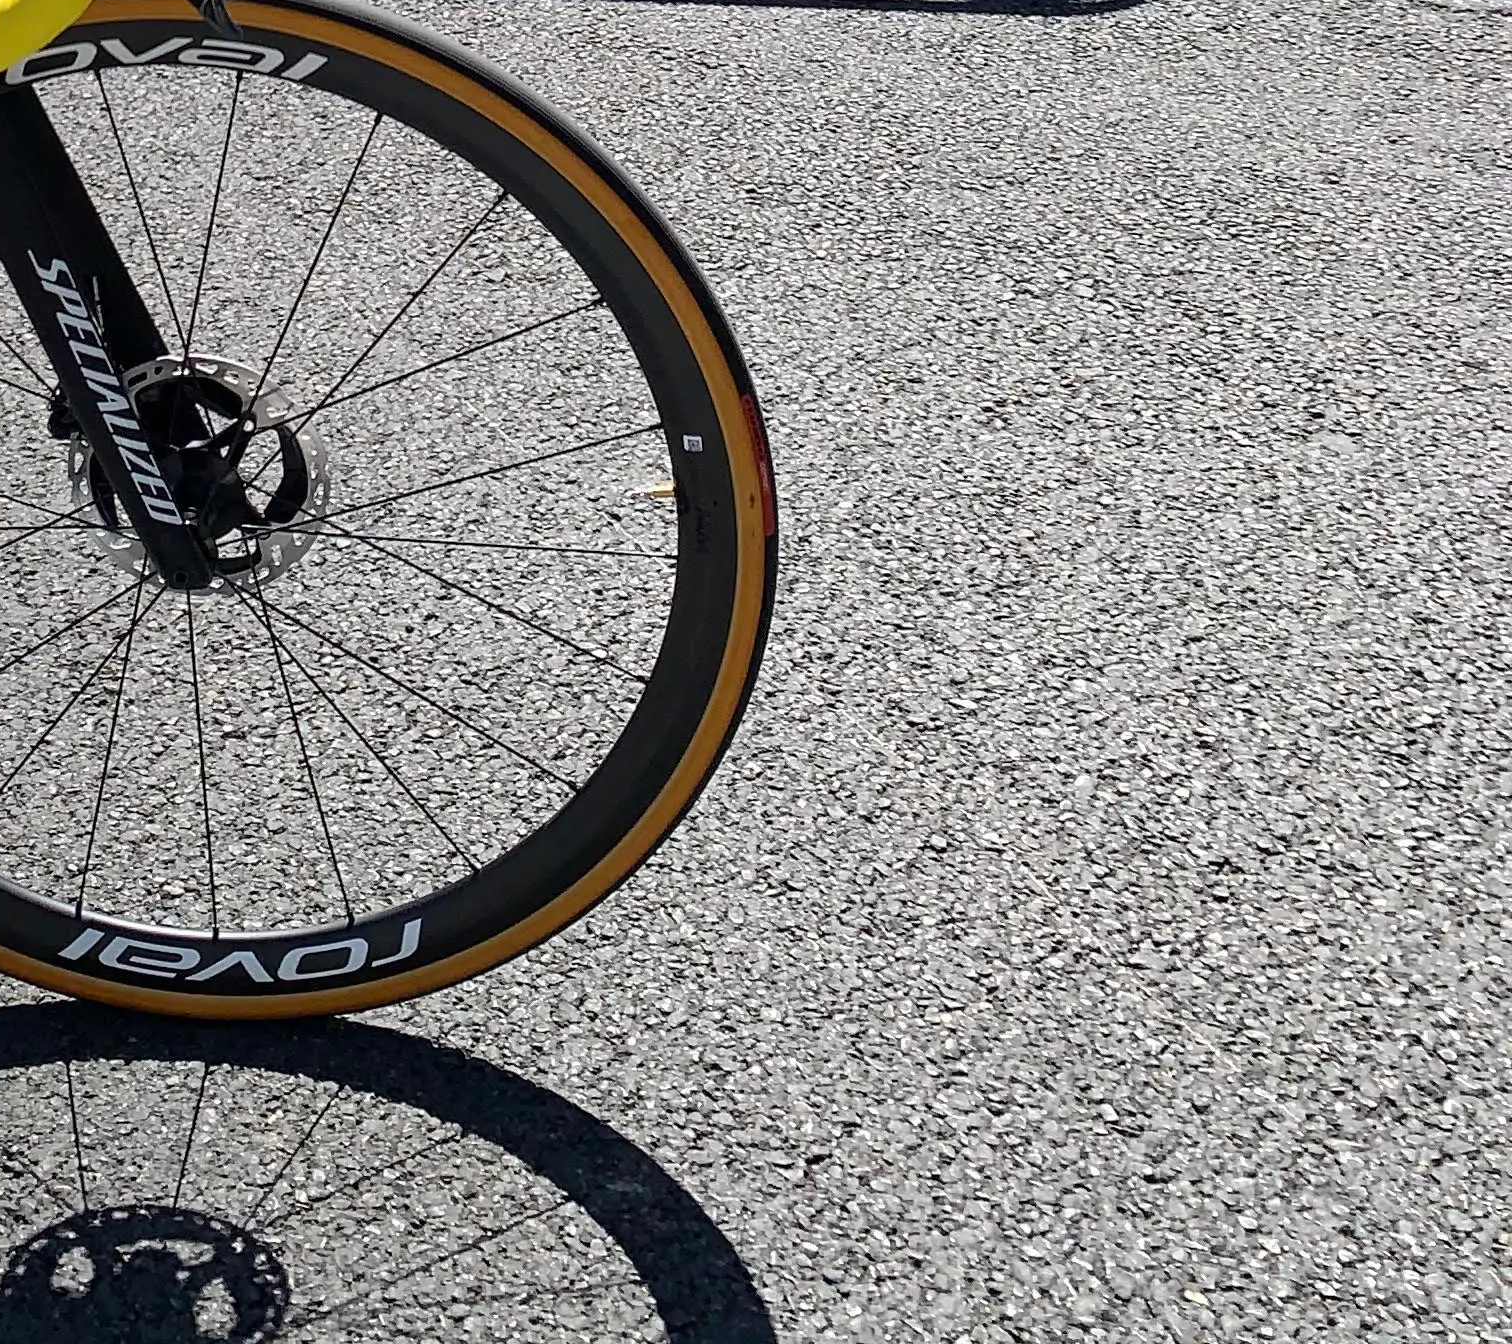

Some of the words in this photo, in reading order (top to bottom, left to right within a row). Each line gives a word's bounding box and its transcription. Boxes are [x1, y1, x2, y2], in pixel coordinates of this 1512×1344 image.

[7, 36, 330, 86] oval
[26, 248, 183, 526] SPECIALIZED
[57, 917, 423, 984] roval
